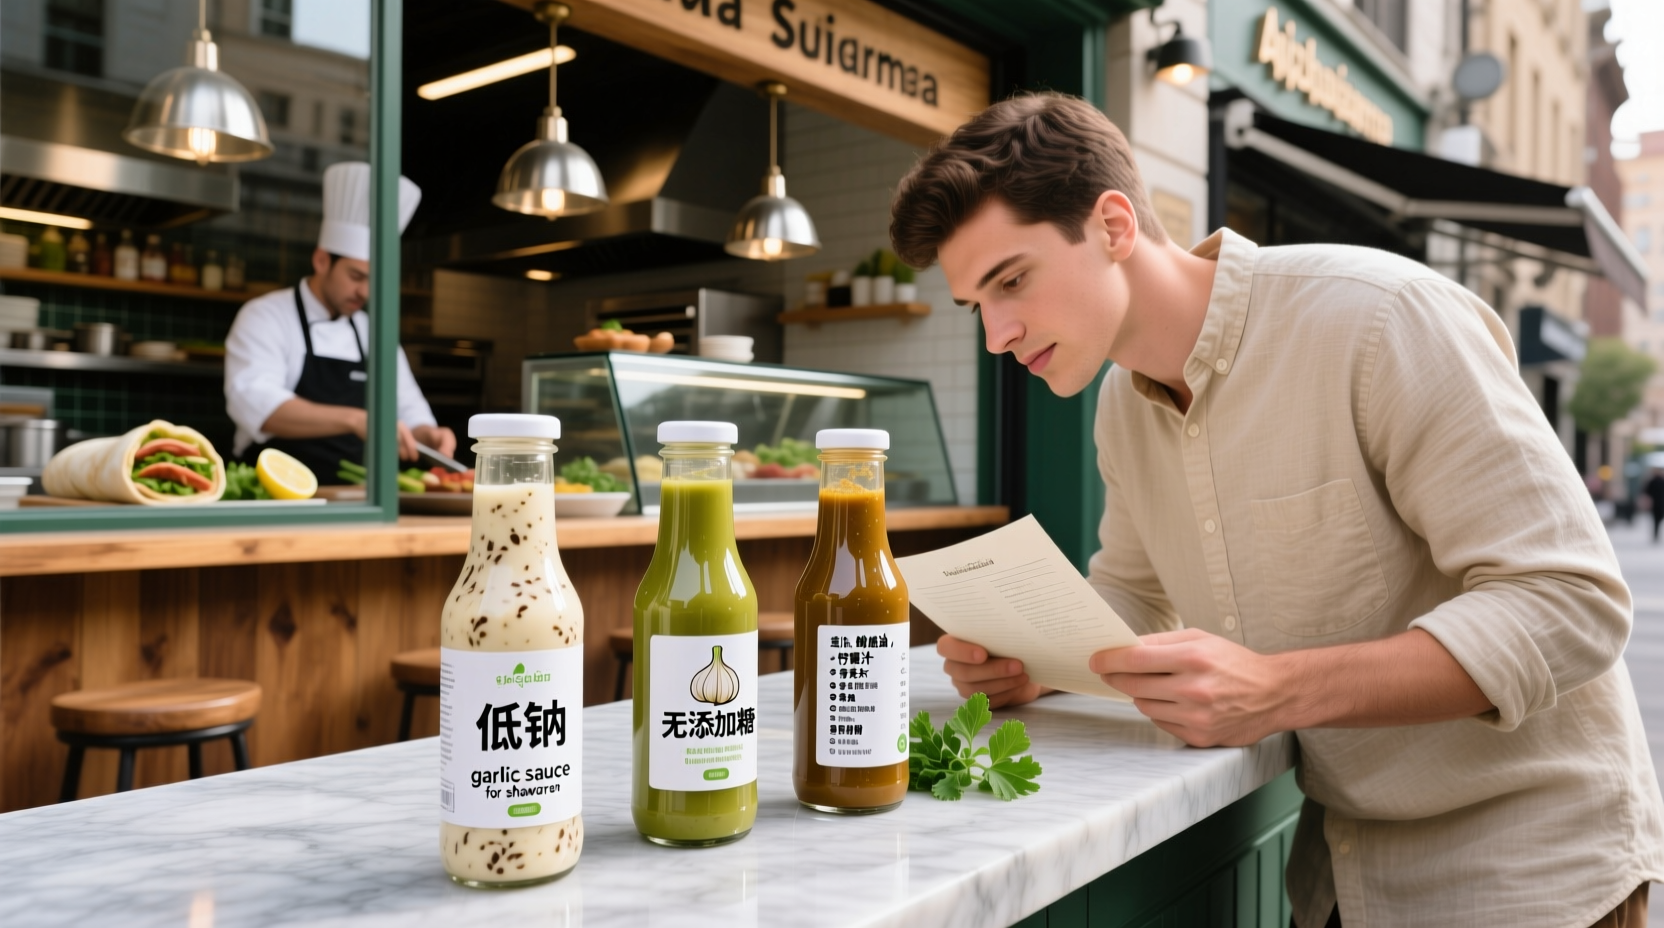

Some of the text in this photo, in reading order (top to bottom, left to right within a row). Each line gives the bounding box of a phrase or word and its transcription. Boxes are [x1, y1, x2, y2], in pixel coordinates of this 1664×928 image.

[476, 699, 566, 752] 低钠
[662, 707, 756, 739] 无添加糖
[471, 764, 571, 788] garlic sauce
[485, 785, 502, 799] for
